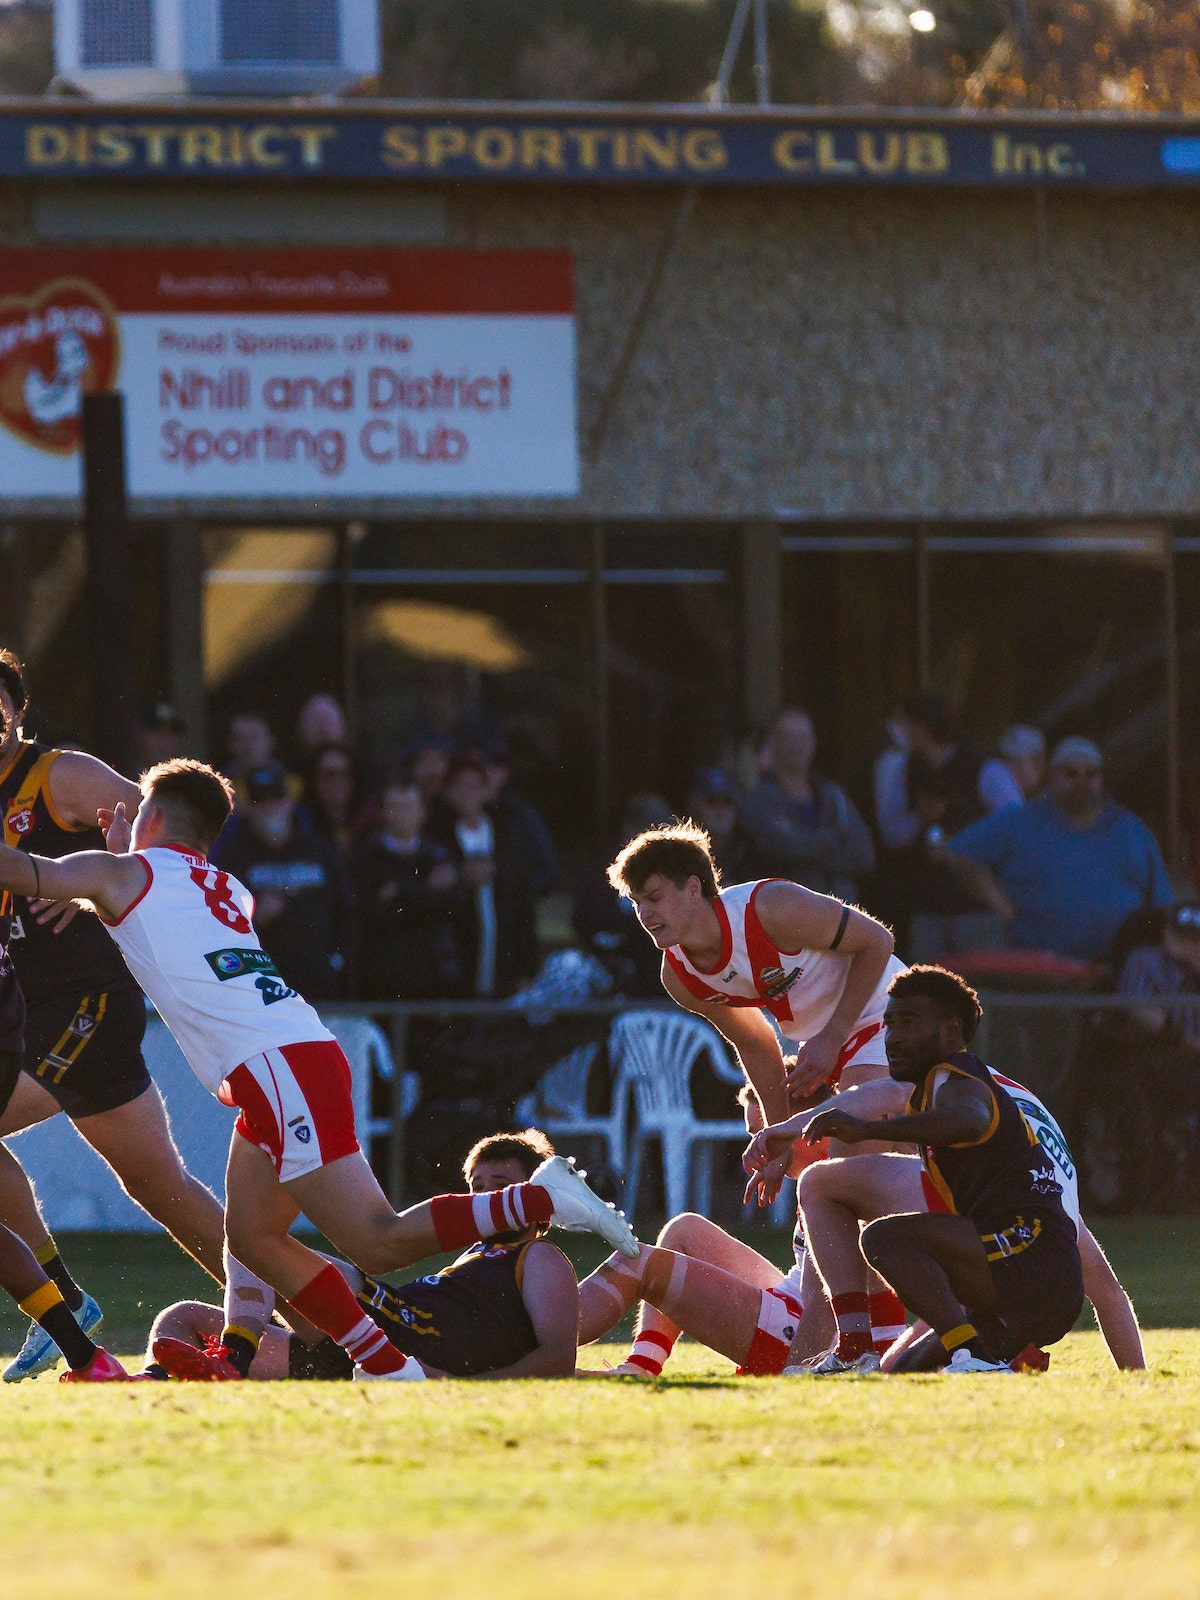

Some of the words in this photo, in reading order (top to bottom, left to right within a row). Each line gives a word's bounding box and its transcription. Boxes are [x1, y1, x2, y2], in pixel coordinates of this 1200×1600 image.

[27, 126, 334, 168] DISTRICT
[382, 127, 726, 171] SPORTING
[773, 131, 949, 174] CLUB
[991, 133, 1086, 176] Inc.
[158, 329, 226, 354] Proud
[233, 329, 336, 358] Sponsors
[343, 330, 369, 354] of
[372, 330, 412, 354] the
[159, 369, 250, 412] Nhill
[261, 369, 356, 413] and
[367, 368, 512, 412] District
[160, 419, 347, 476] Sporting
[359, 417, 468, 464] Club
[190, 866, 252, 934] 8
